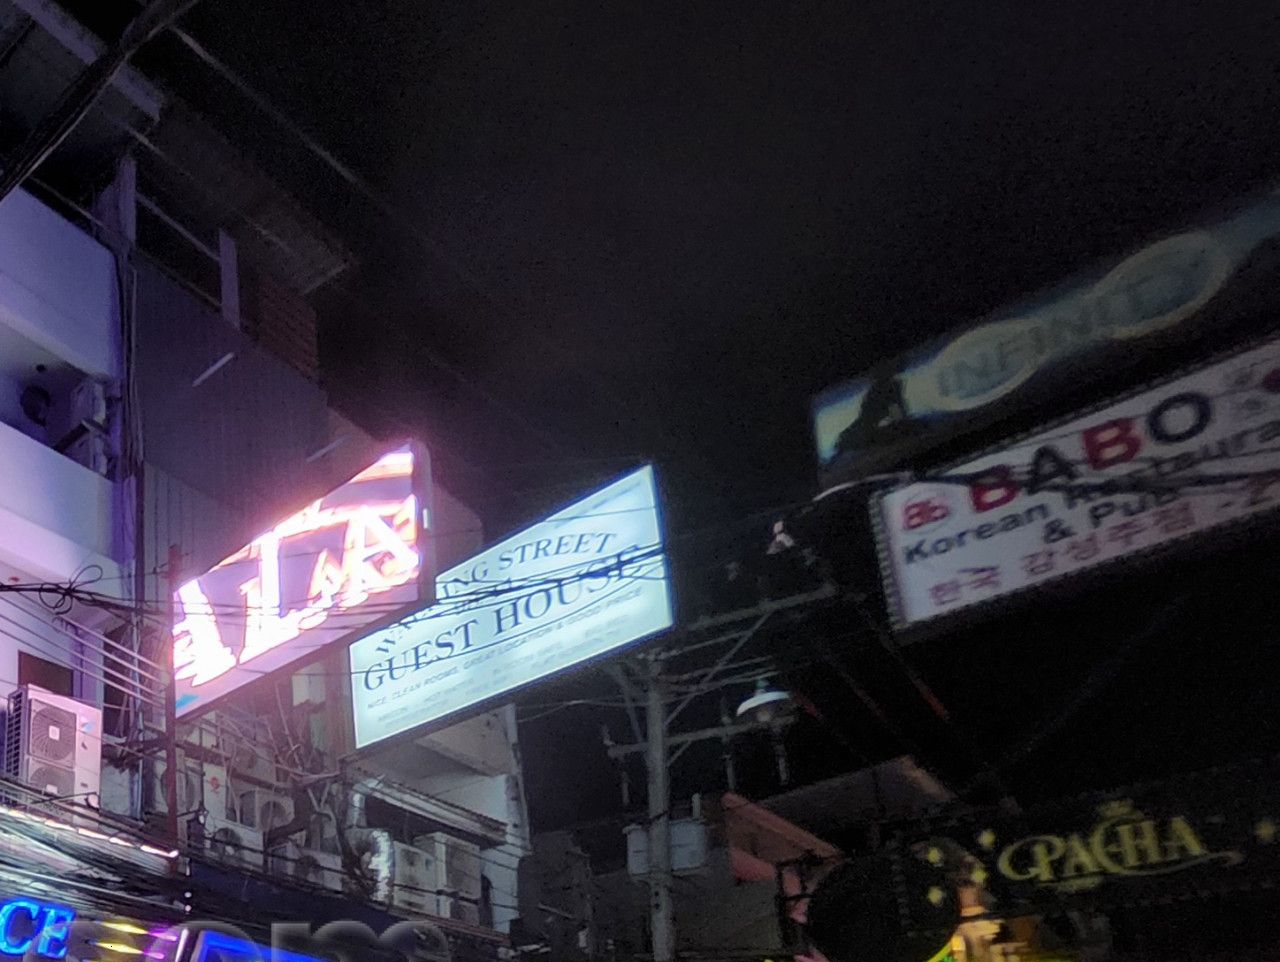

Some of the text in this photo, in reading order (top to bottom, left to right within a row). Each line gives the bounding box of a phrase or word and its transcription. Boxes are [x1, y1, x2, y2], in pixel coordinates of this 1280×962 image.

[969, 392, 1211, 512] BABO
[499, 531, 617, 572] STREET
[902, 502, 1050, 565] Korean
[1044, 518, 1077, 545] &
[363, 619, 480, 692] GUEST
[493, 545, 644, 637] HOUSE
[997, 813, 1220, 891] PACHA
